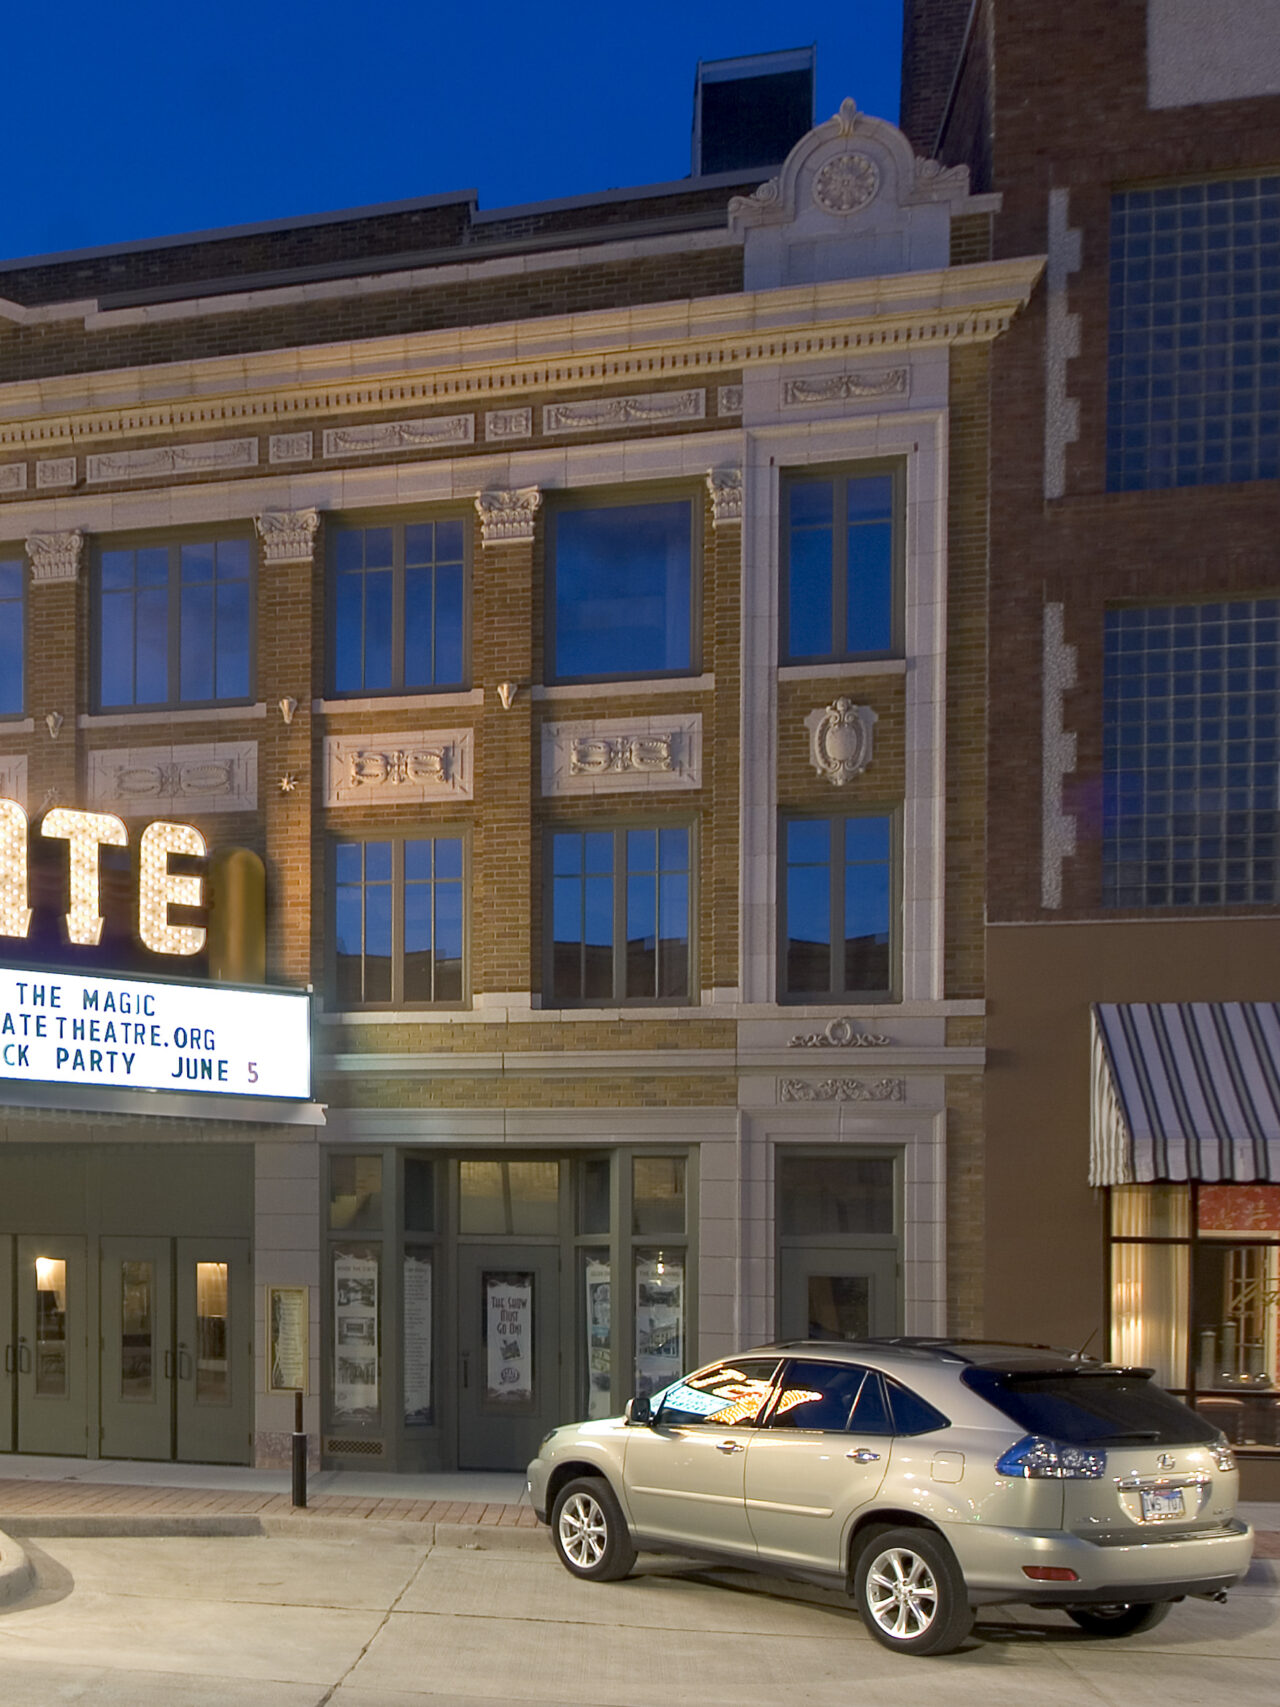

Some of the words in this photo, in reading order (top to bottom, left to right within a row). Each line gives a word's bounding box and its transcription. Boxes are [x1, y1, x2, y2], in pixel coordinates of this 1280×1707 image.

[16, 982, 62, 1009] THE
[82, 988, 156, 1017] MAGIC
[56, 1047, 136, 1075] PARTY
[171, 1056, 229, 1082] JUNE
[247, 1061, 259, 1084] 5
